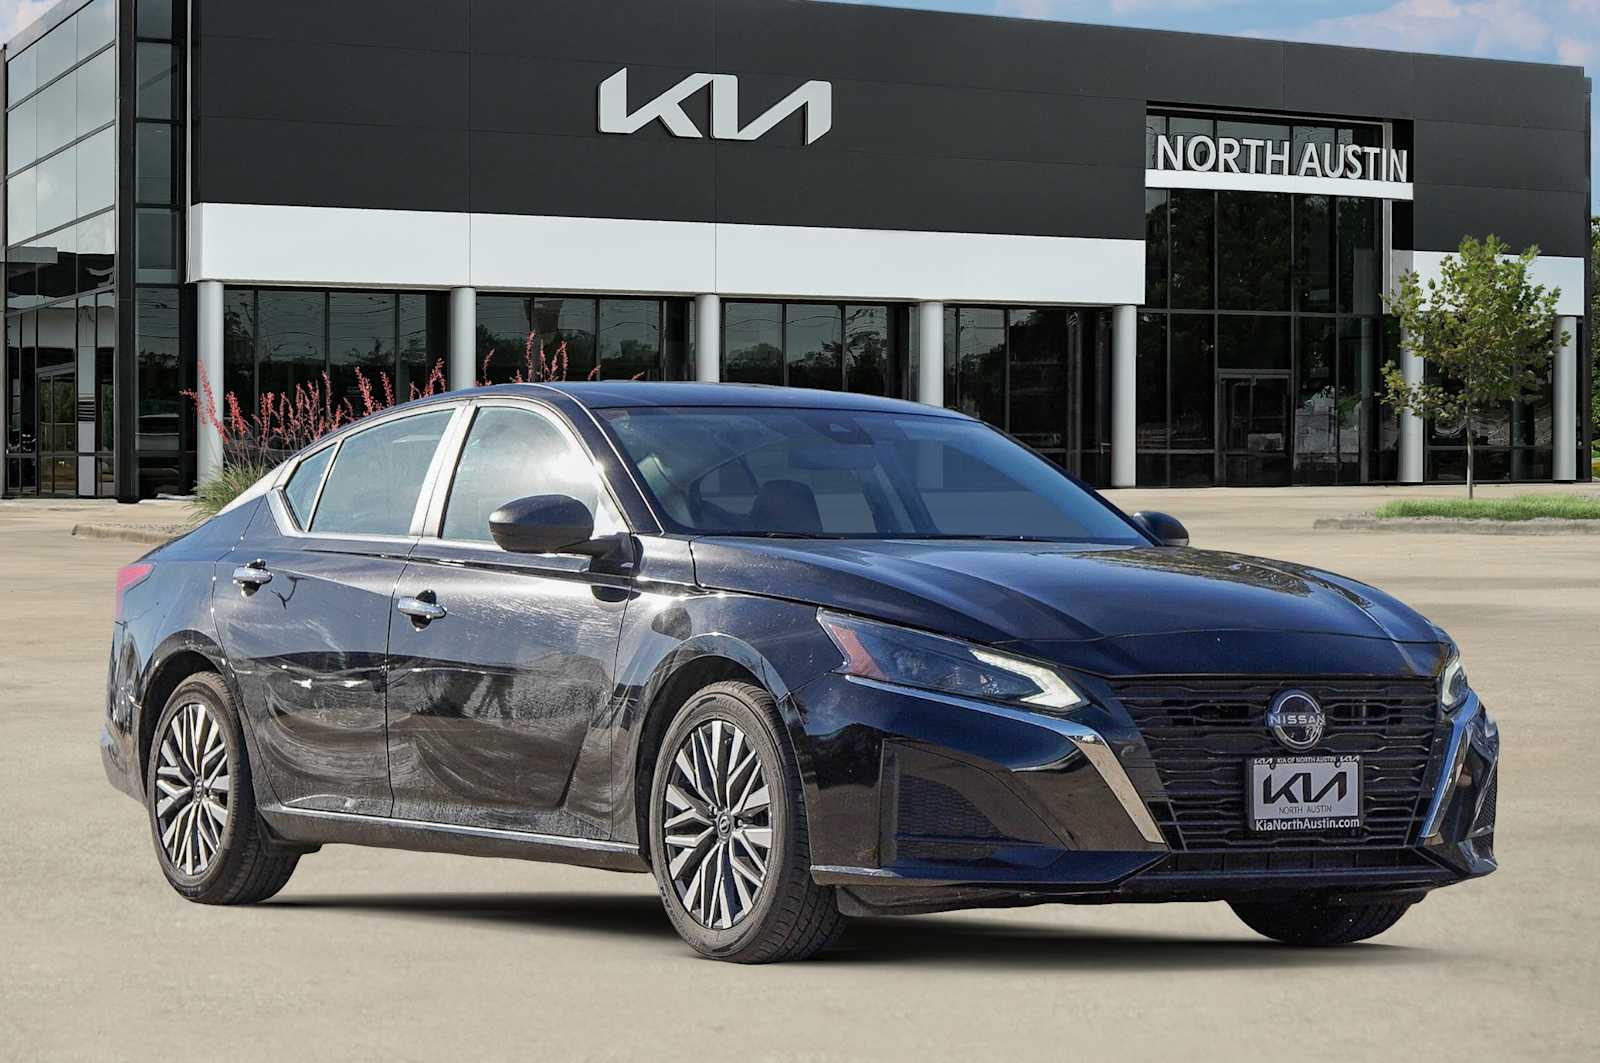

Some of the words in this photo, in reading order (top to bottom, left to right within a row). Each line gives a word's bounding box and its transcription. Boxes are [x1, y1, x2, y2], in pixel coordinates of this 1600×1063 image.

[599, 67, 832, 145] KIA
[1157, 134, 1290, 176] NORTH
[1299, 142, 1408, 182] AUSTIN
[1270, 714, 1326, 725] NISSAN
[1263, 771, 1347, 804] KIA
[1279, 806, 1303, 815] NORTH
[1306, 804, 1333, 813] AUSTIN
[1256, 817, 1360, 831] KiaNorthAustin.com
